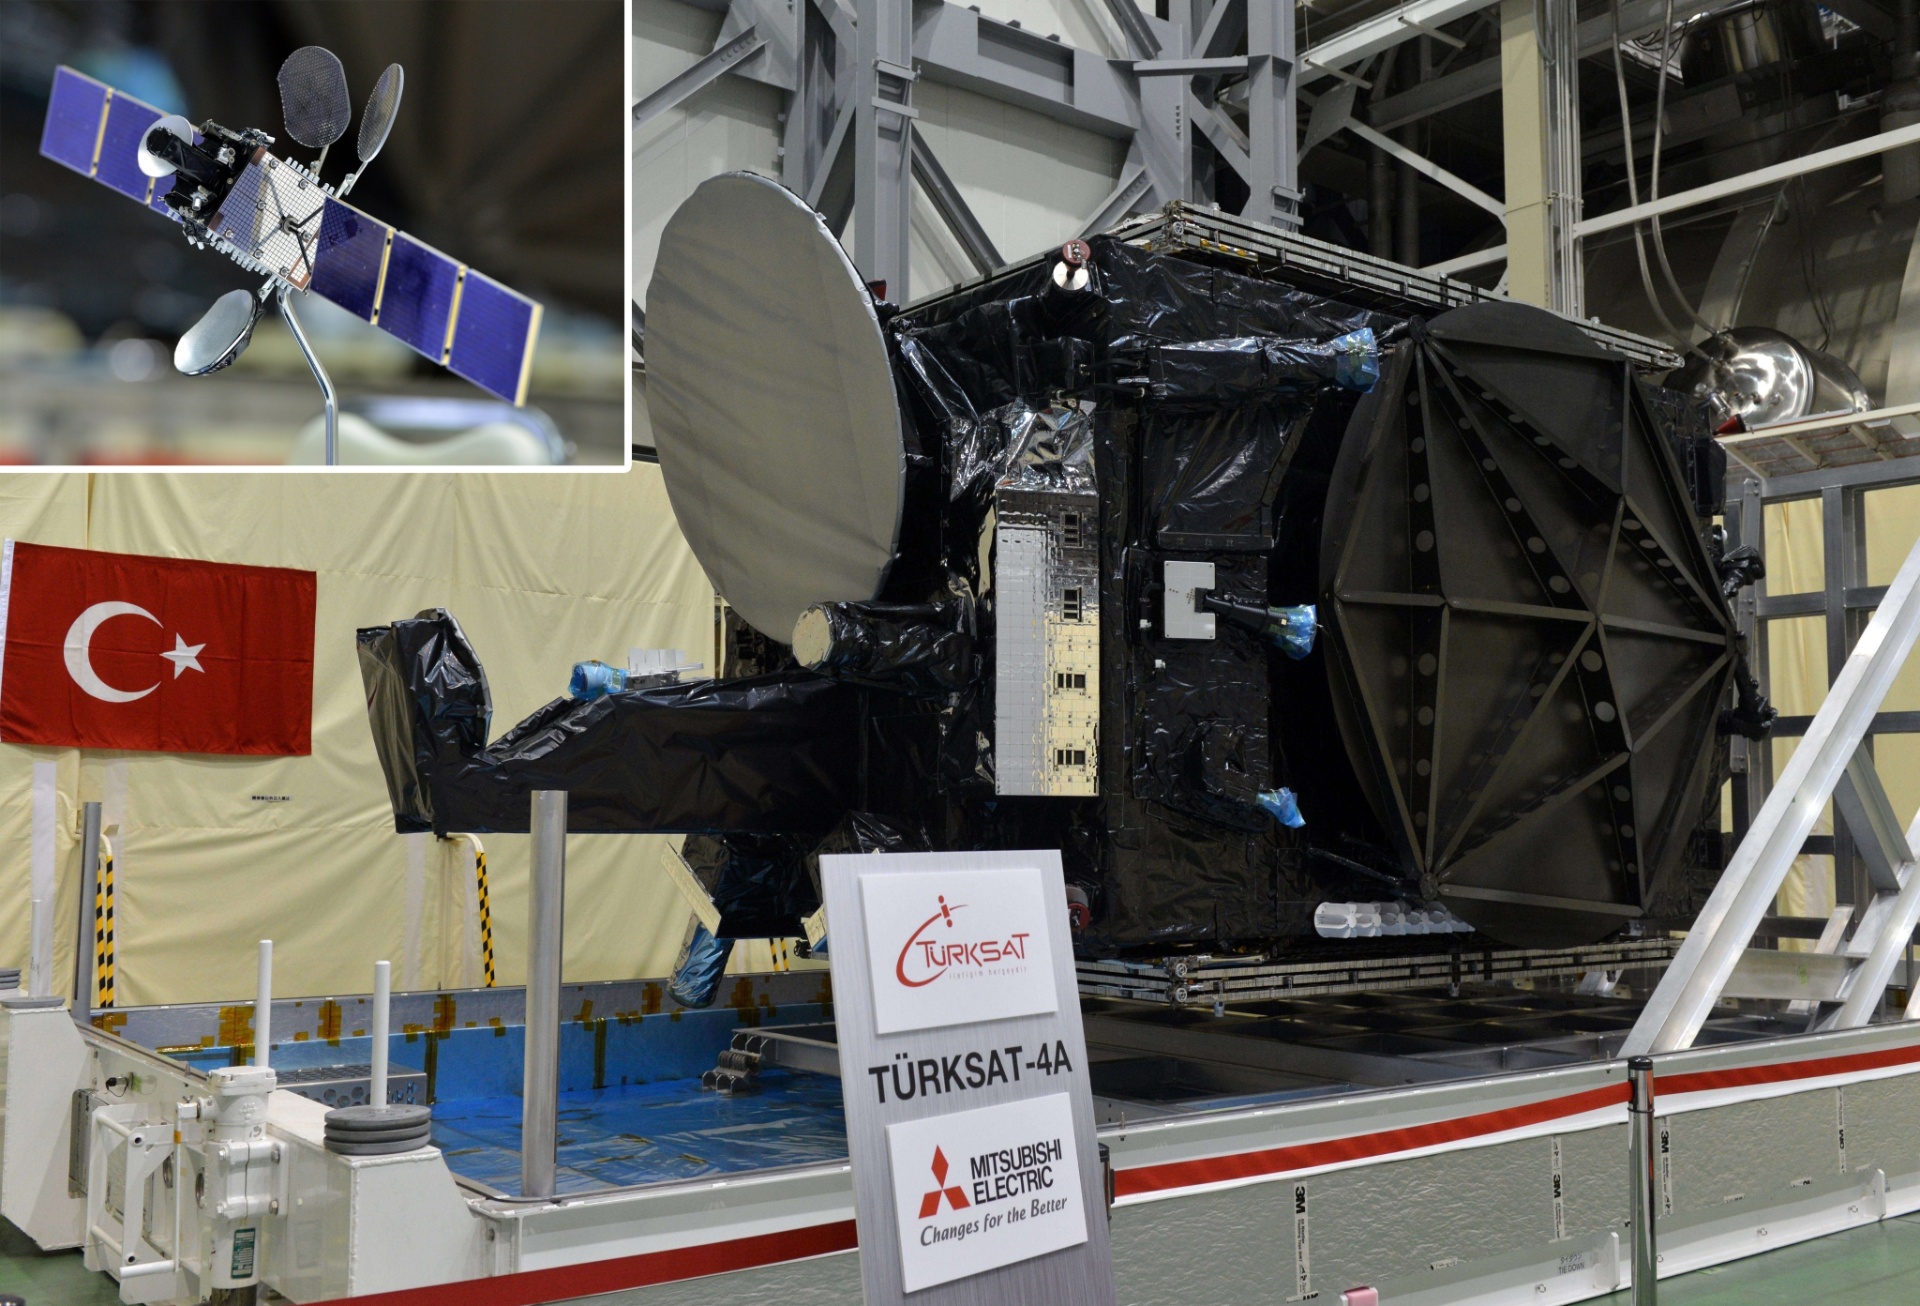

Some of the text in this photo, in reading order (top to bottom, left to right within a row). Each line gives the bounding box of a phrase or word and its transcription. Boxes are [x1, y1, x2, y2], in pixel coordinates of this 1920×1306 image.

[915, 933, 1030, 968] TÜRKSAT
[868, 1039, 1074, 1103] TÜRKSAT-4A
[970, 1138, 1062, 1180] MITSUBISHI
[1660, 1130, 1669, 1154] 3M
[973, 1165, 1054, 1205] ELECTRIC
[1295, 1186, 1306, 1214] 3M
[1553, 1174, 1561, 1199] 3M
[920, 1197, 1068, 1247] Changes for the Better
[1558, 1262, 1585, 1274] TIE DOWN
